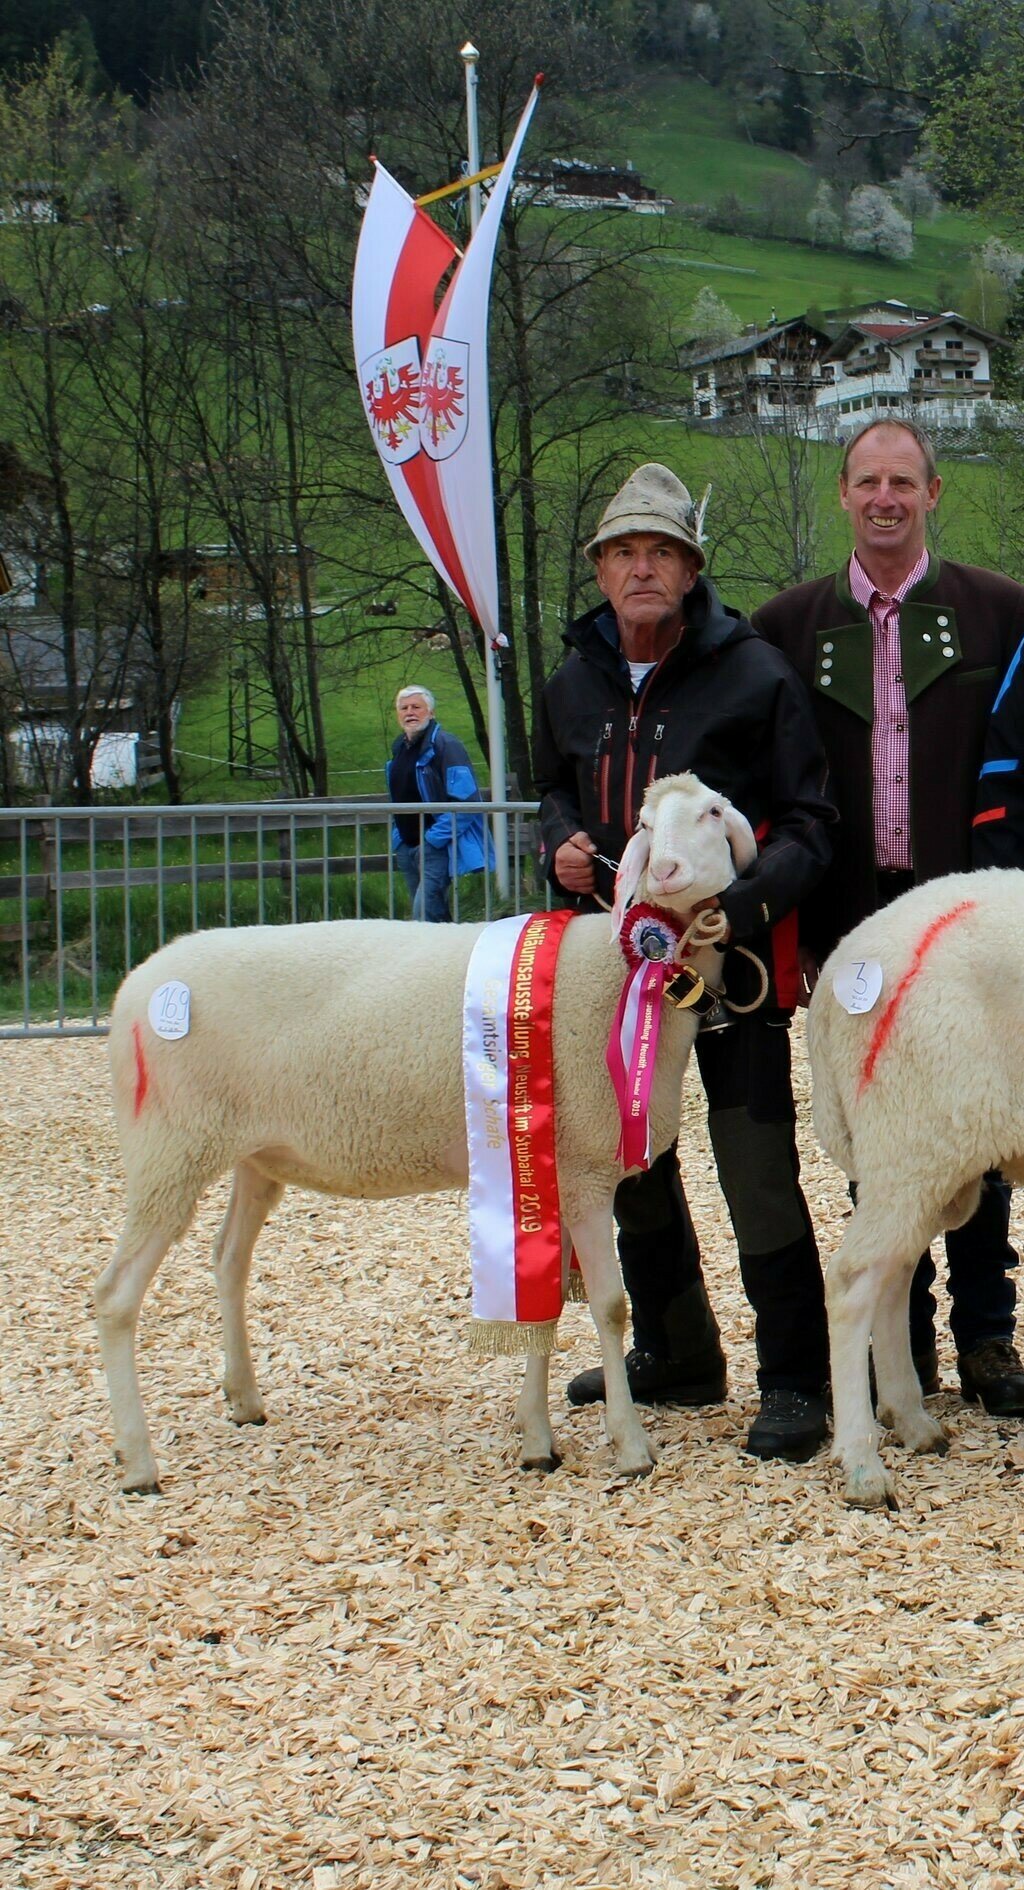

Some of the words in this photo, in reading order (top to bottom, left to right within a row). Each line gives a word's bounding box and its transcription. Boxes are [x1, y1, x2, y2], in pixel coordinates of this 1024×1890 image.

[851, 961, 868, 996] 3
[158, 986, 189, 1021] 169
[477, 979, 503, 1088] Gesamtsieger
[638, 1042, 650, 1069] Neustift
[514, 1064, 533, 1113] Neustift
[483, 1098, 507, 1150] Schafe
[514, 1116, 533, 1132] im
[631, 1099, 641, 1117] 2019
[515, 1134, 537, 1187] Stubaital
[519, 1193, 542, 1233] 2019
